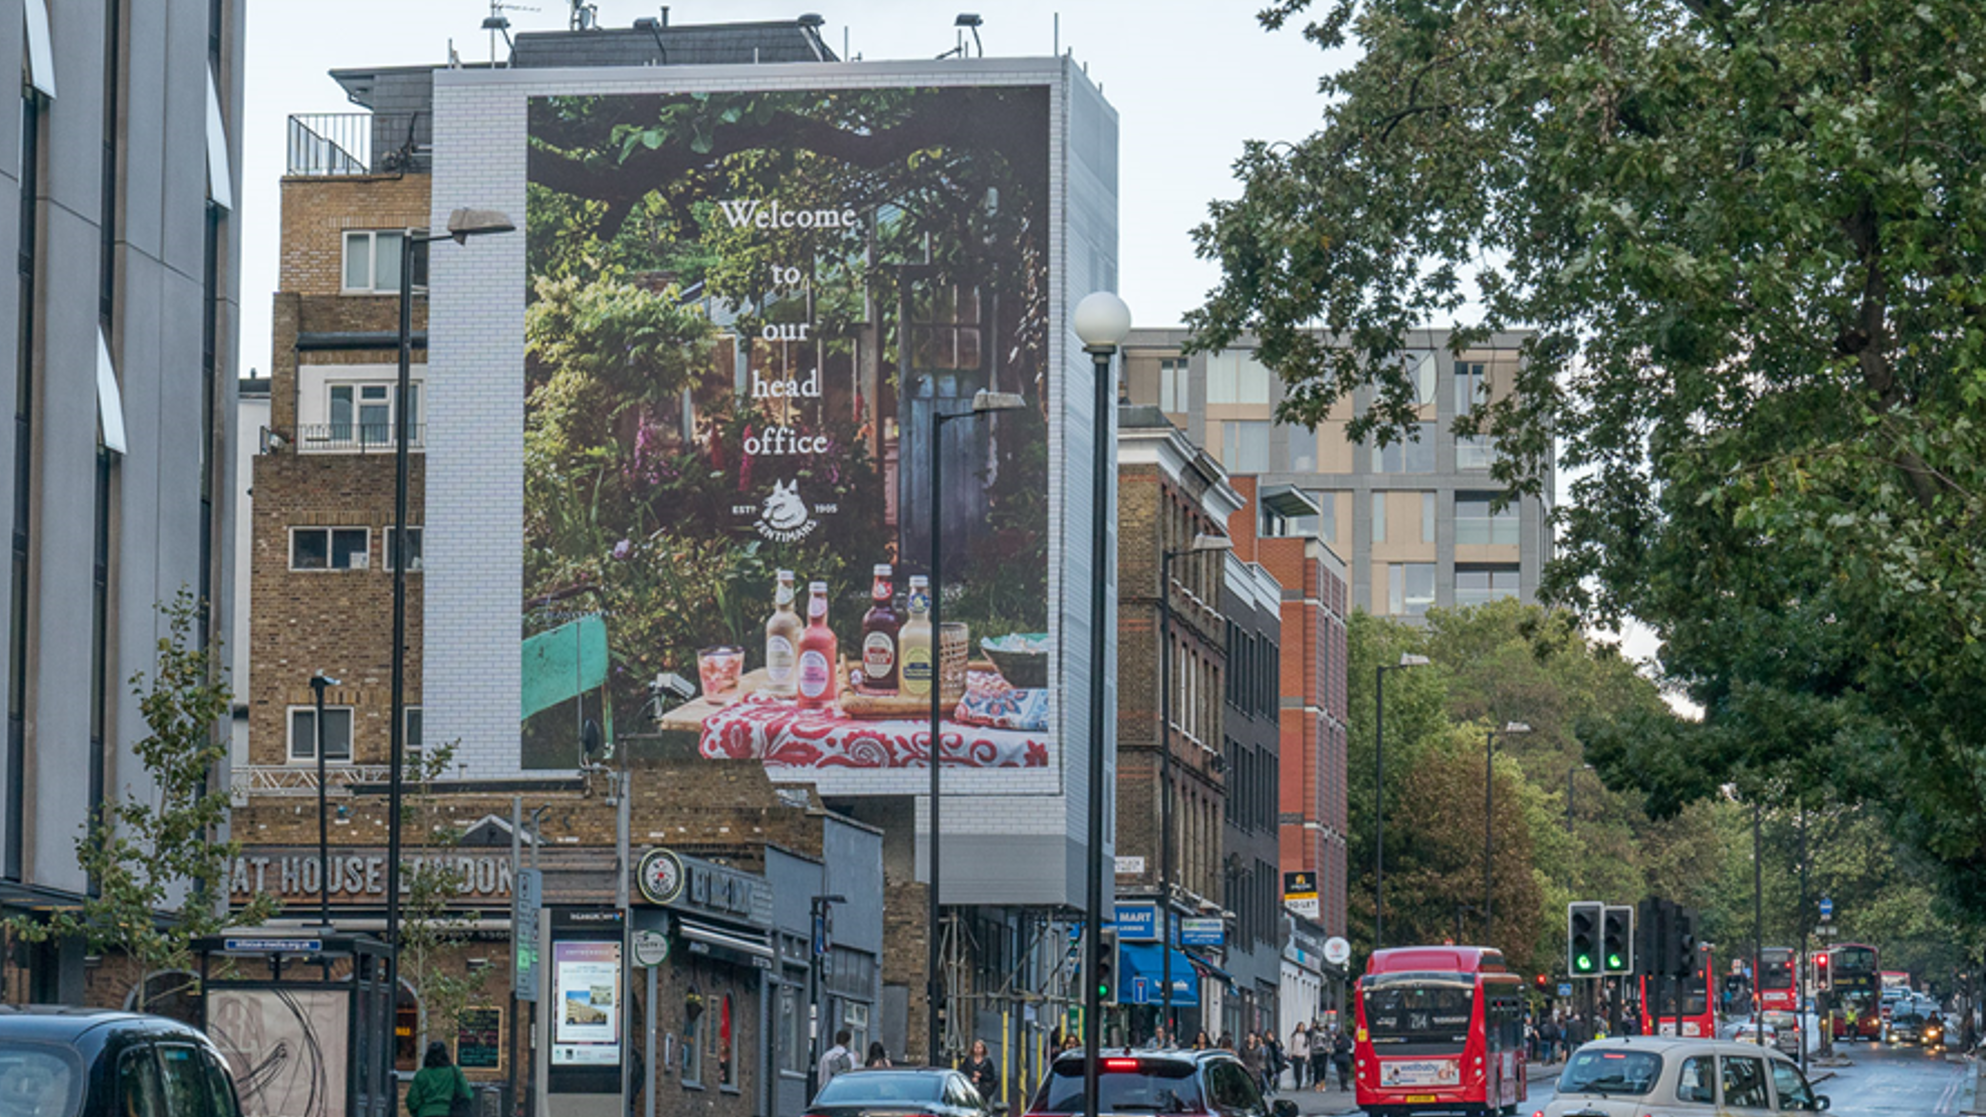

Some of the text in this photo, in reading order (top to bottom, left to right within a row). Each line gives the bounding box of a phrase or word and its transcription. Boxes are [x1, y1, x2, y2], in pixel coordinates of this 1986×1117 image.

[719, 200, 857, 229] Welcome
[771, 264, 801, 285] to
[761, 321, 810, 342] our
[751, 368, 820, 399] head
[743, 426, 828, 456] office
[814, 503, 838, 513] 1905
[753, 519, 819, 543] FENTIMANS
[281, 857, 383, 894] HOUSE
[1119, 912, 1152, 922] MART
